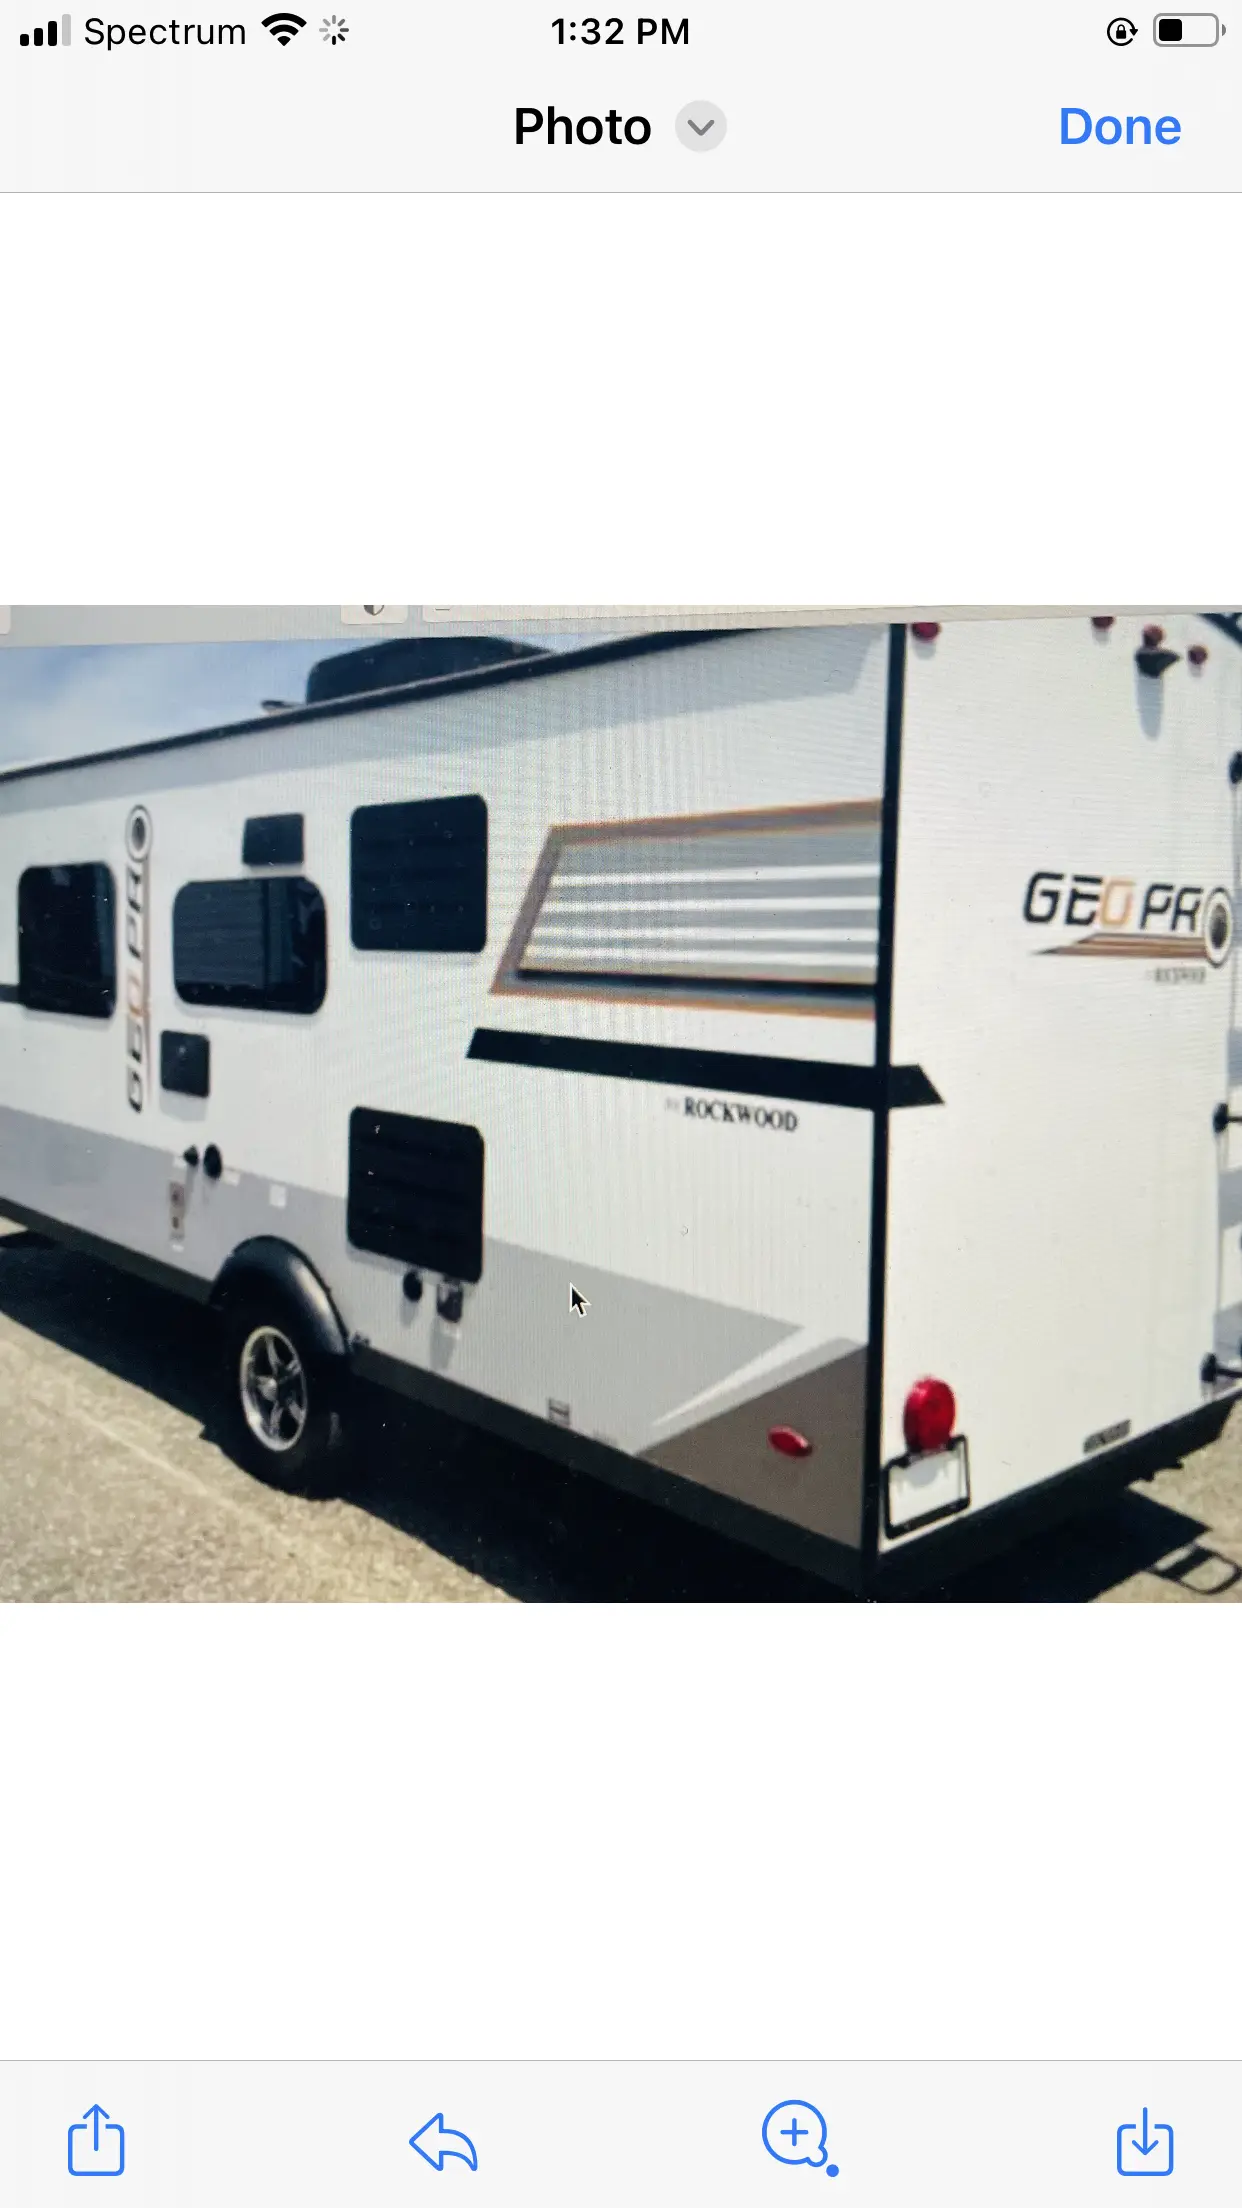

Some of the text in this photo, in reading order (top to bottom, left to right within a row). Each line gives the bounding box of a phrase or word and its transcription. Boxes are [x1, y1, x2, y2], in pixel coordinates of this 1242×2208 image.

[84, 17, 247, 52] Spectrum
[551, 17, 690, 46] 1:32 PM
[515, 105, 652, 146] Photo
[1060, 107, 1182, 146] Done
[1022, 870, 1232, 969] GEO PRO
[684, 1096, 799, 1133] ROCKWOOD
